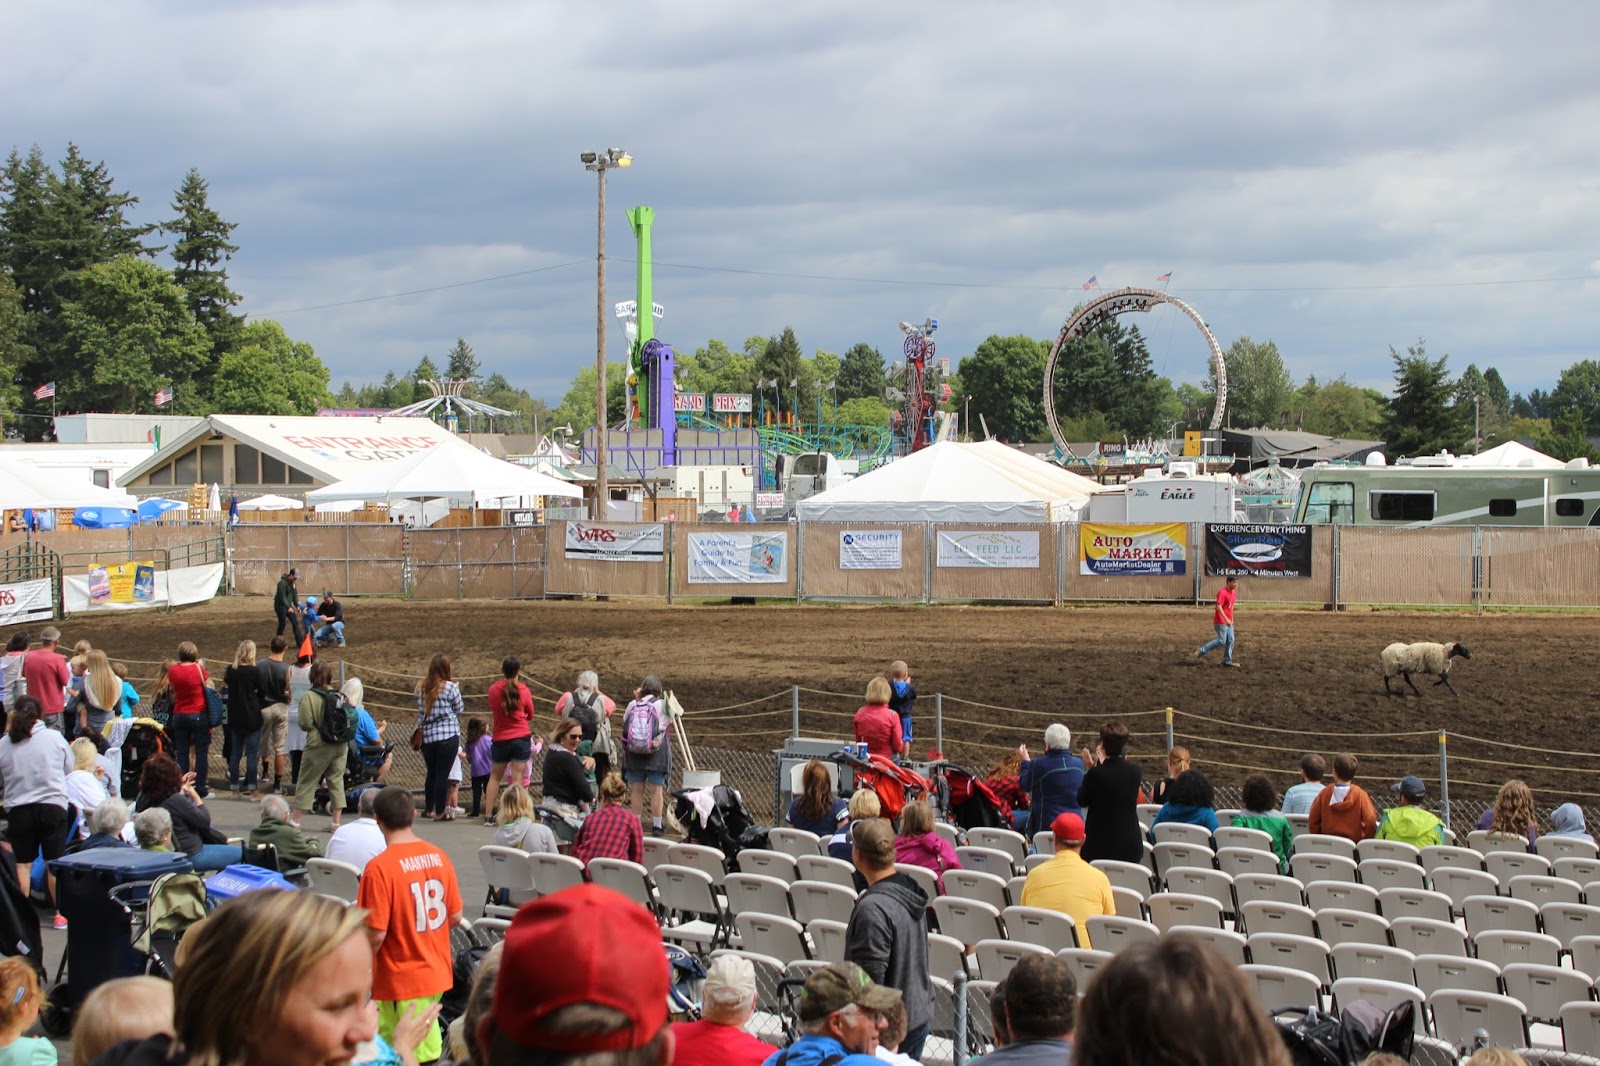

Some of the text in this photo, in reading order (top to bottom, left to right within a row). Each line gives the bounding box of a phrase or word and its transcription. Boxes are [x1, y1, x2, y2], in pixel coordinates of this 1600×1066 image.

[674, 395, 737, 410] RAND PRIX
[1103, 444, 1121, 452] RING
[1161, 491, 1196, 500] EAGLE
[576, 526, 617, 543] WRS
[1093, 536, 1133, 547] AUTO
[727, 549, 735, 557] to
[977, 545, 999, 554] FEED
[1006, 545, 1022, 554] LLC
[1109, 548, 1174, 559] MARKET
[694, 559, 719, 568] Family
[1093, 560, 1162, 569] AutoMarketDealer
[1259, 569, 1283, 577] Minutes
[0, 590, 16, 606] RS
[399, 853, 443, 873] MANNING
[410, 878, 448, 933] 18
